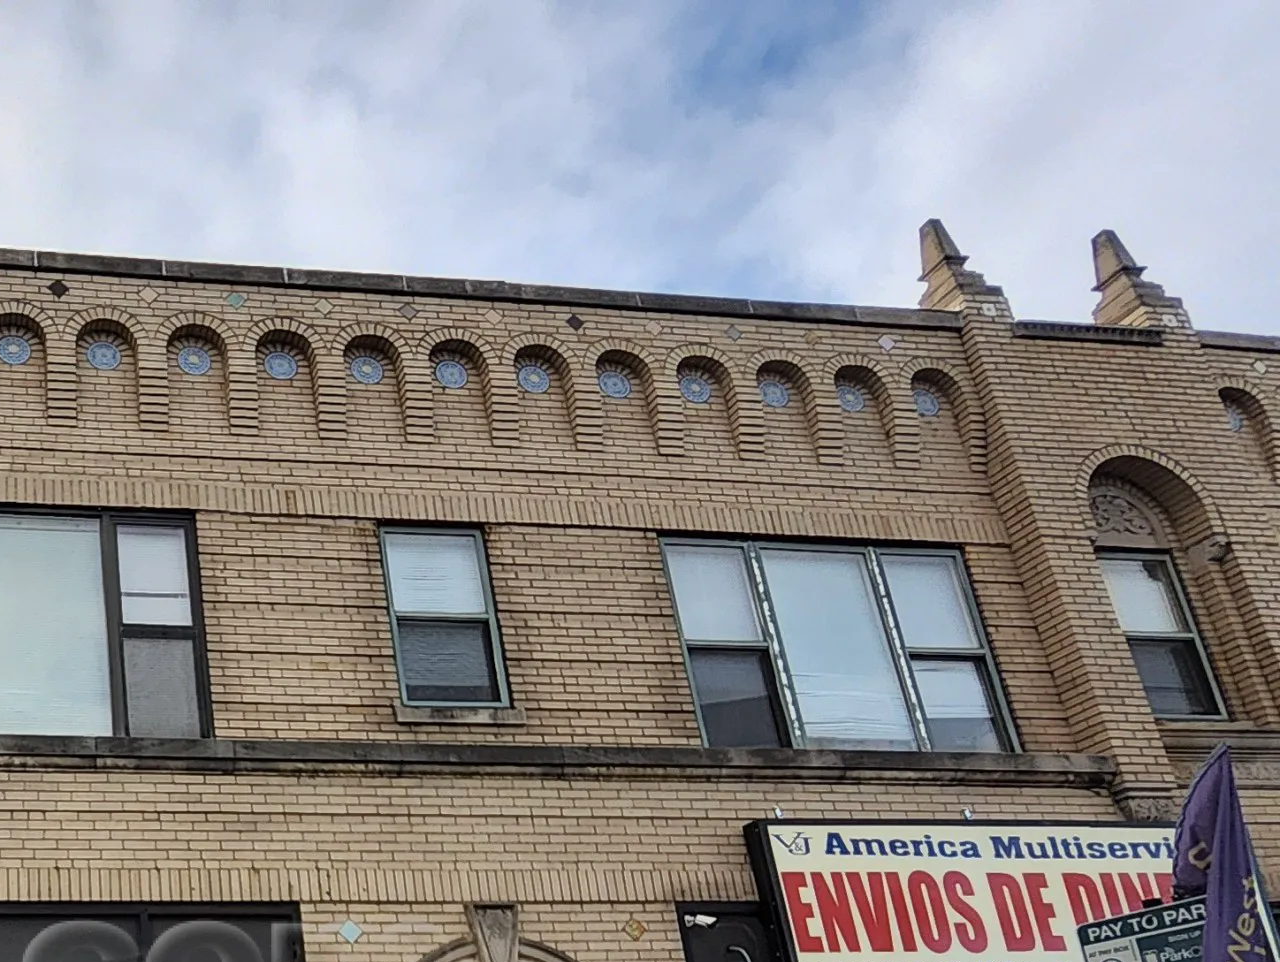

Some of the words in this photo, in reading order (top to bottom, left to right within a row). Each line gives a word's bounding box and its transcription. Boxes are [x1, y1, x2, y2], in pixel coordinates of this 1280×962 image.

[825, 832, 982, 859] America
[781, 870, 988, 954] ENVIOS
[986, 872, 1068, 952] DE
[1087, 921, 1122, 943] PAY
[1126, 914, 1158, 933] TO
